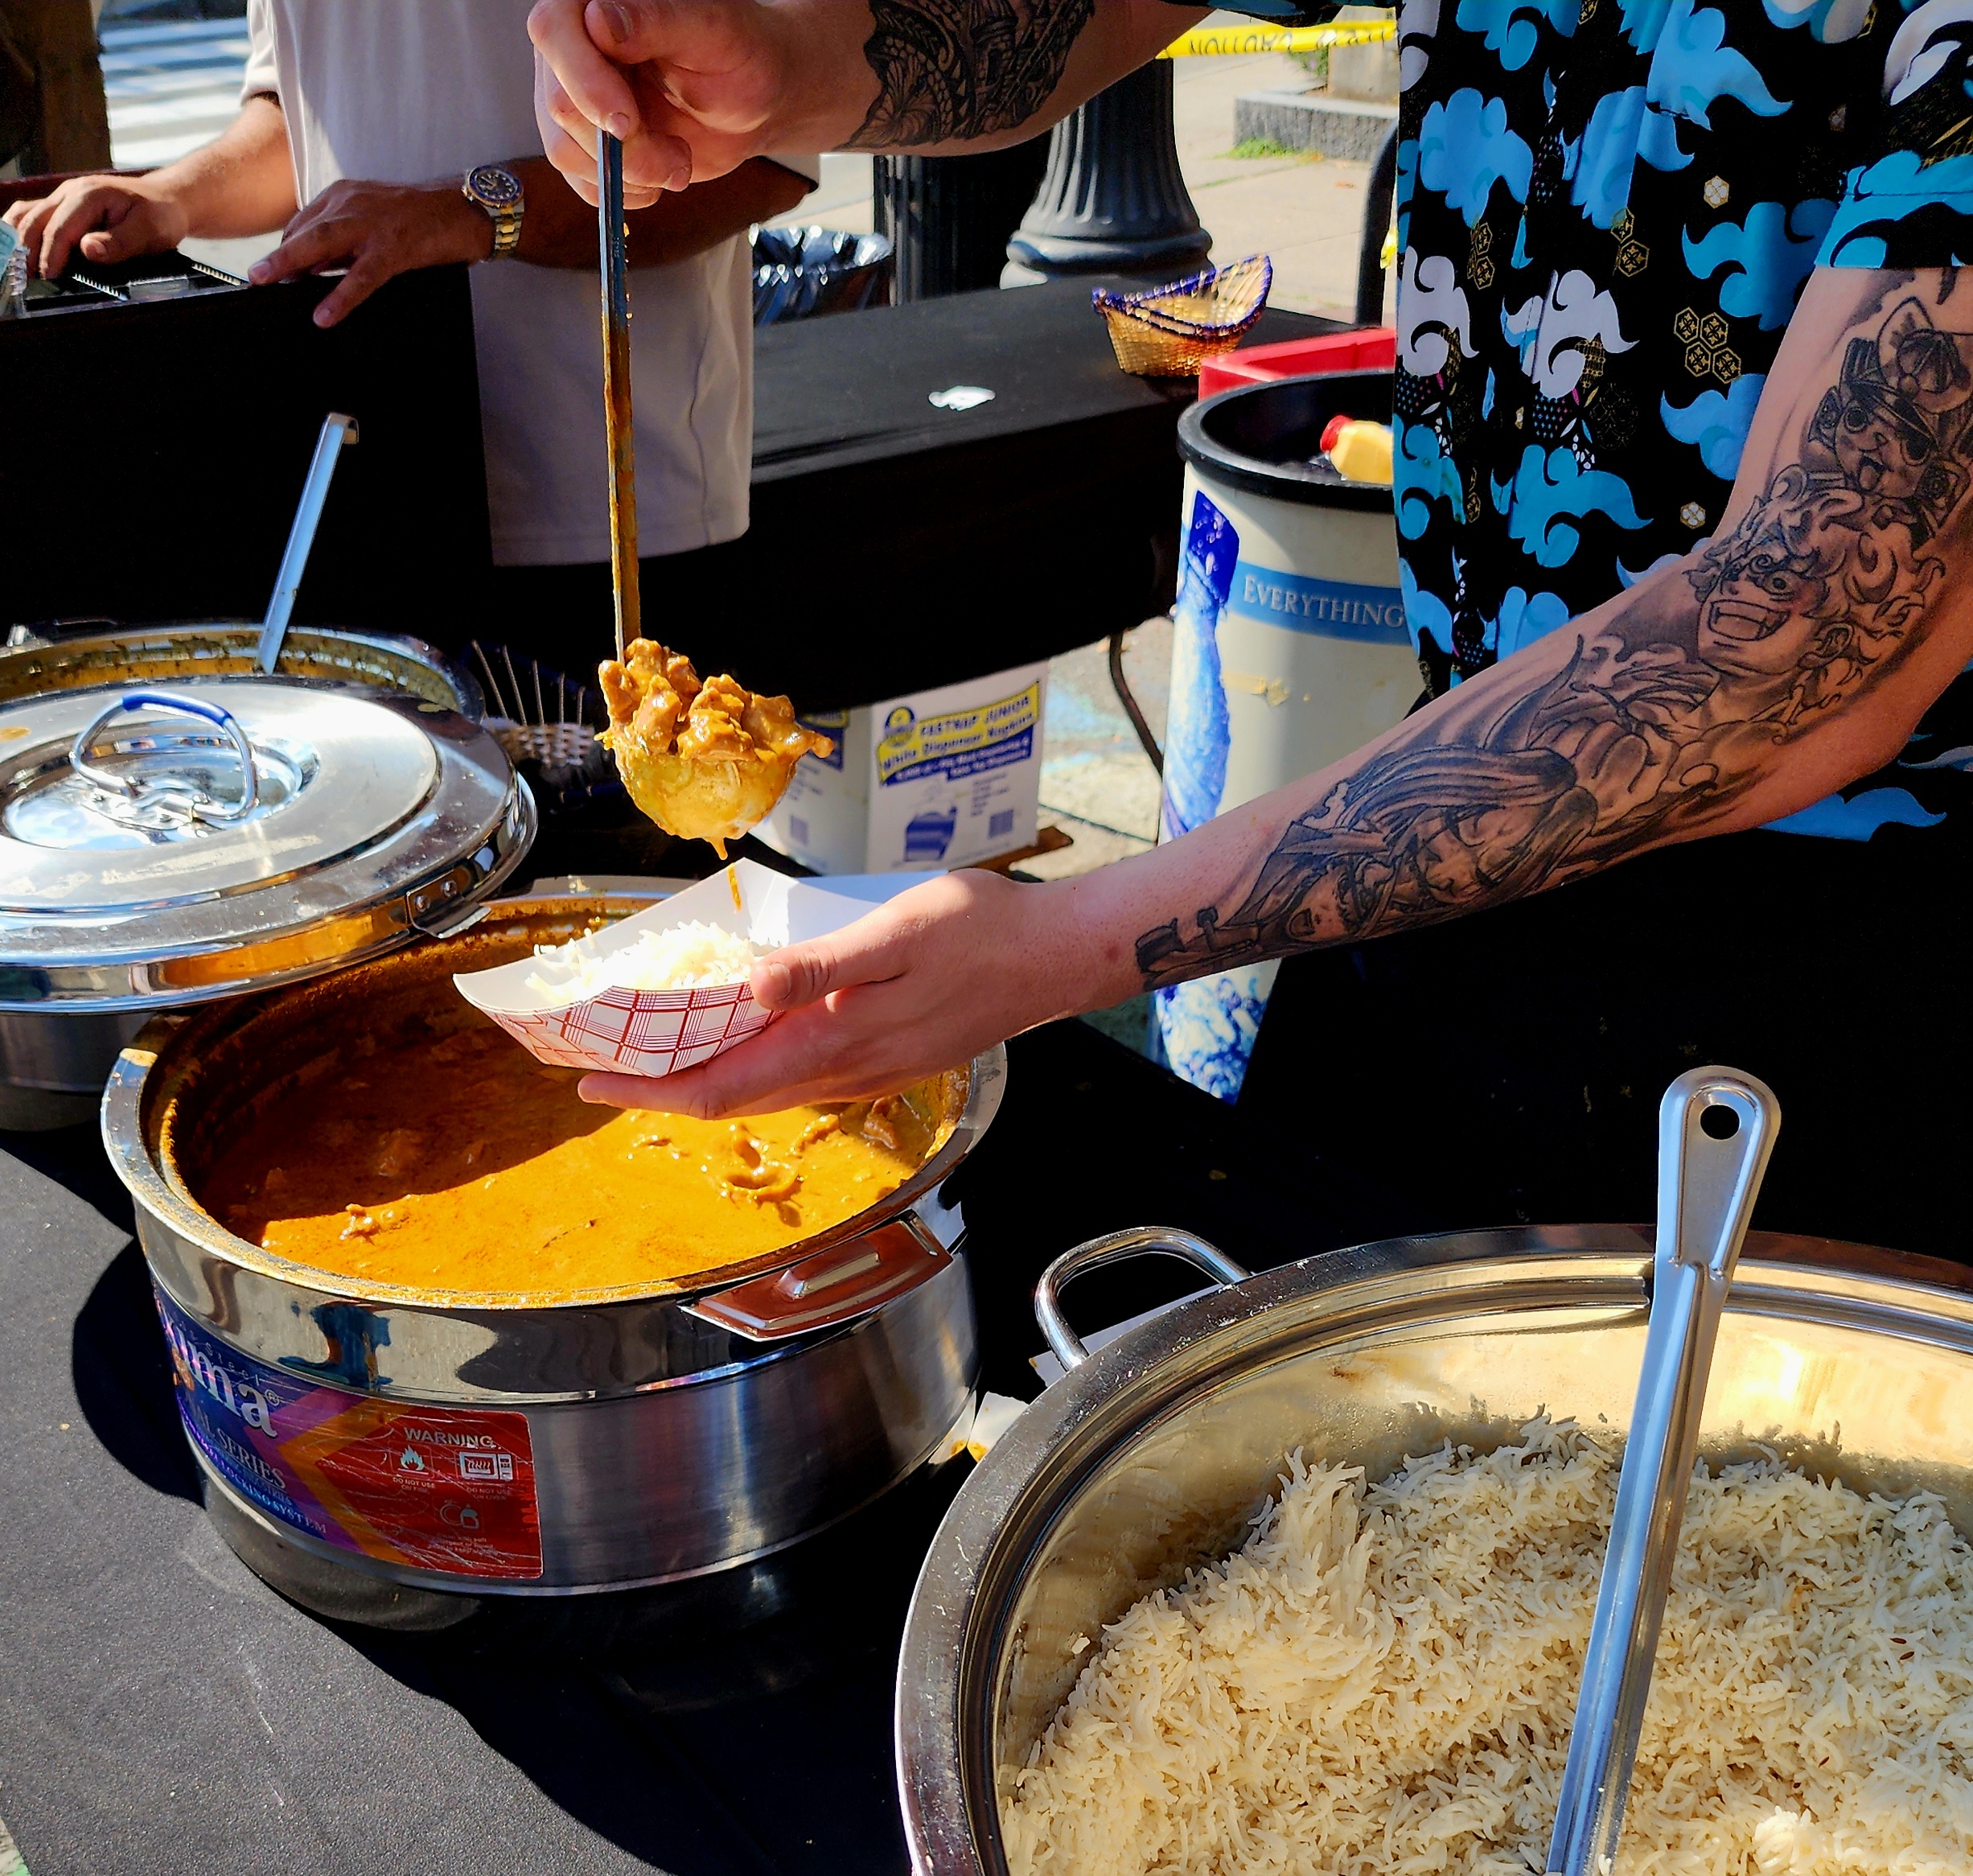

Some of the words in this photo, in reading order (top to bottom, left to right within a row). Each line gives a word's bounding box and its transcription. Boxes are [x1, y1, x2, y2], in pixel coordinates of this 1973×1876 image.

[404, 1427, 495, 1447] WARNING
[216, 1427, 286, 1489] SERIES
[272, 1501, 327, 1533] SYSTEM
